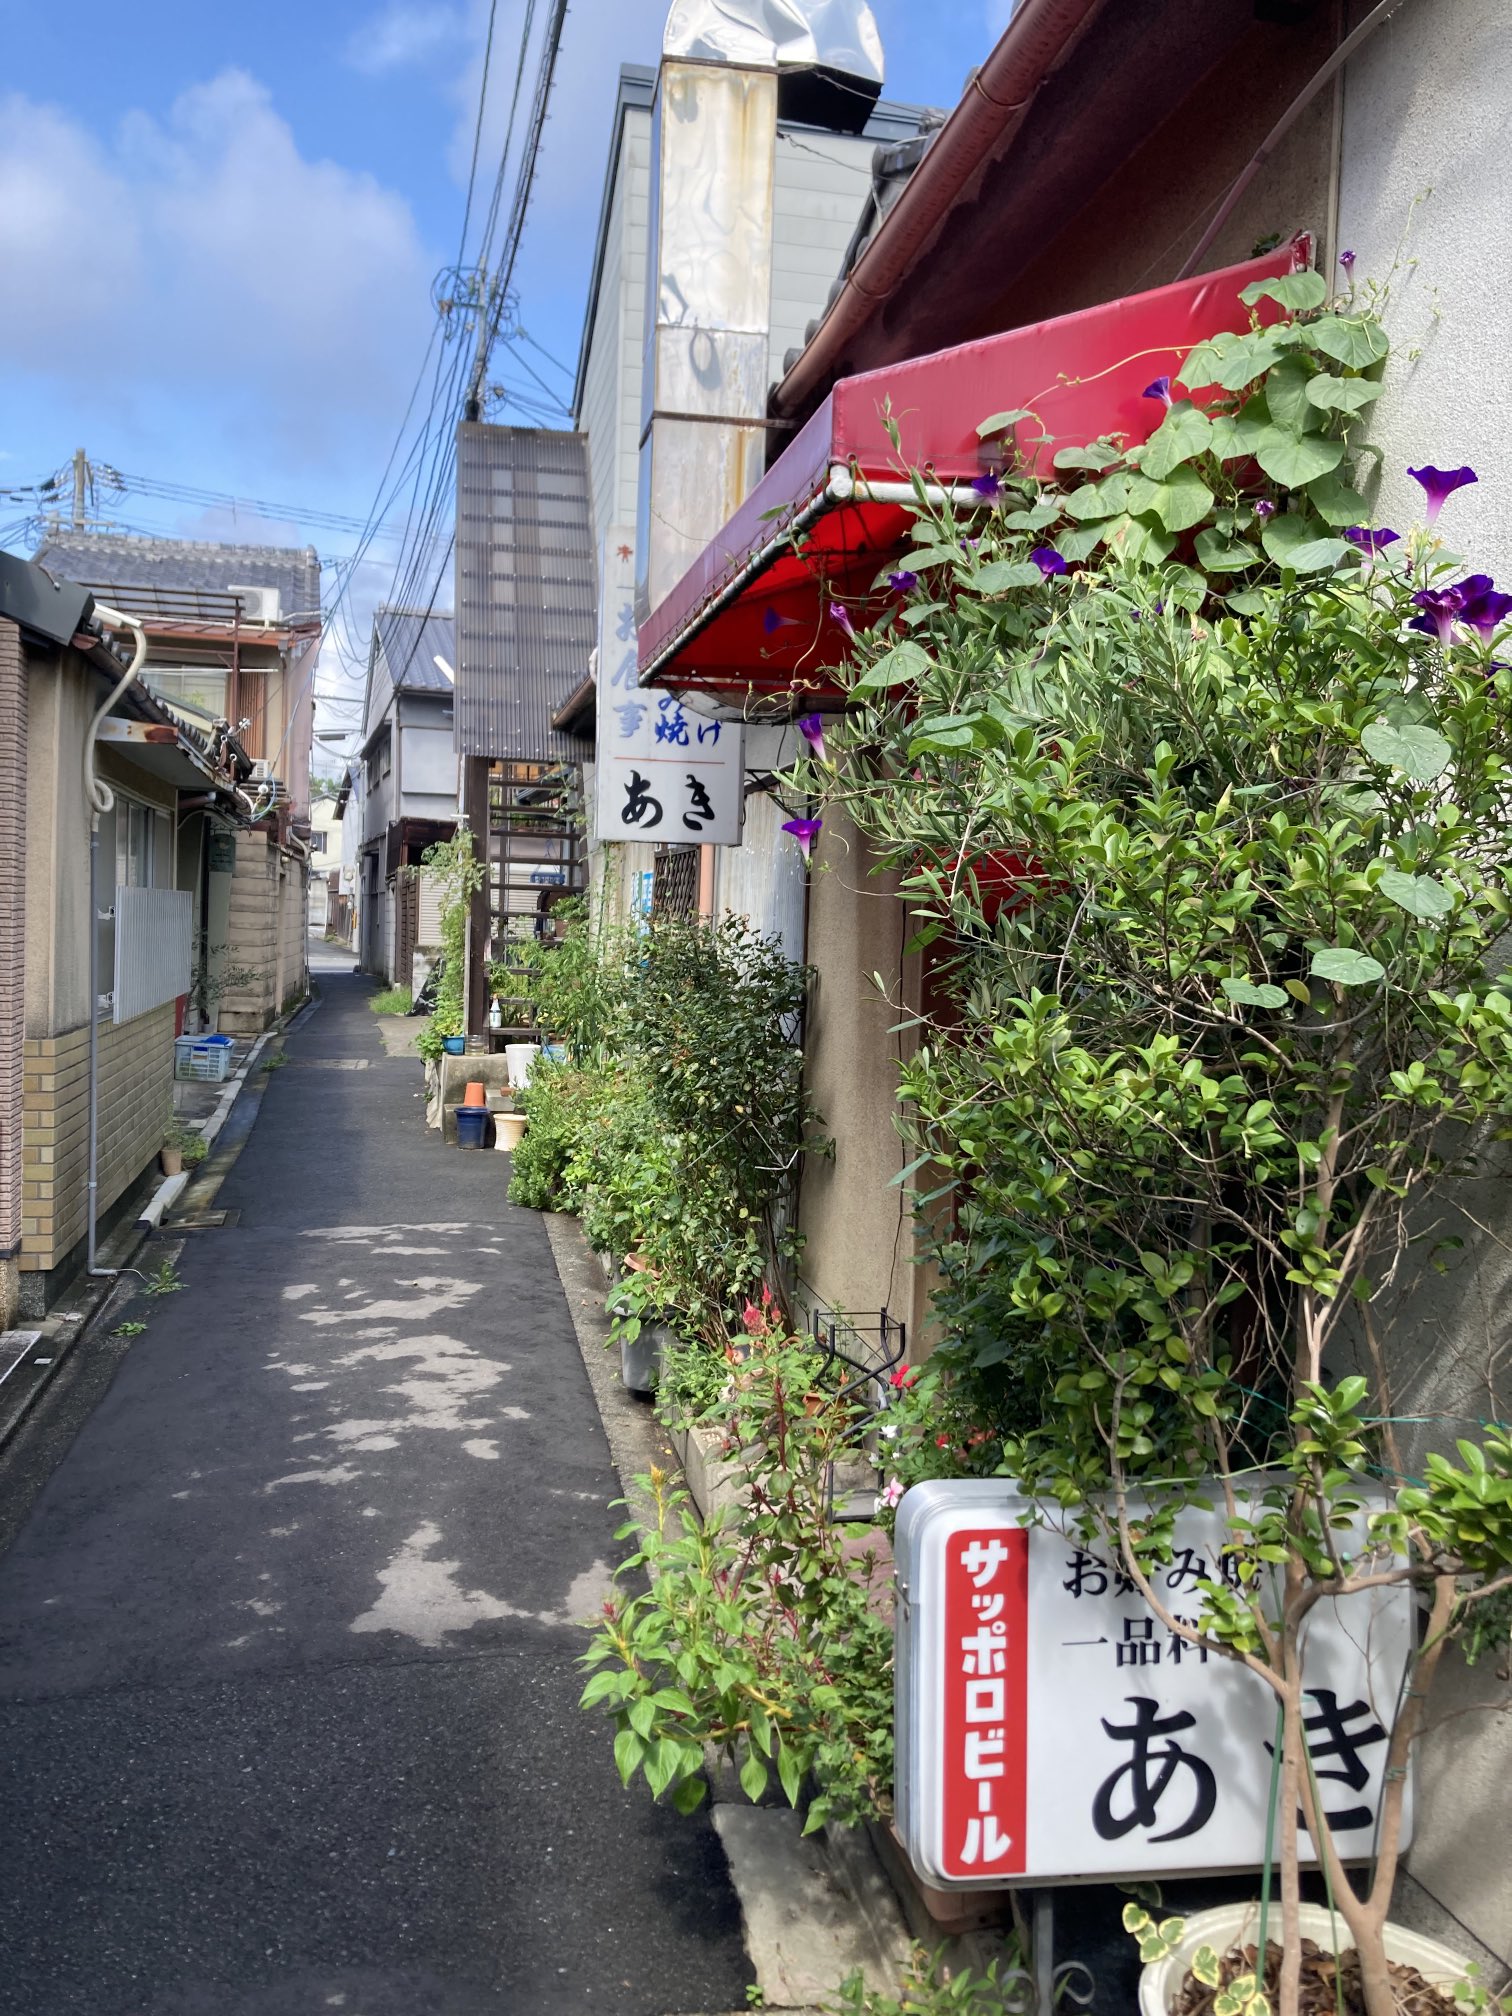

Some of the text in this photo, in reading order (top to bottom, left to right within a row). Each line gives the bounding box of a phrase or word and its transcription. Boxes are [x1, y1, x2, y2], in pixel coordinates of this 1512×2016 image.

[620, 770, 716, 831] あき
[960, 1540, 1011, 1864] サッポロビール
[1092, 1688, 1387, 1843] あき
